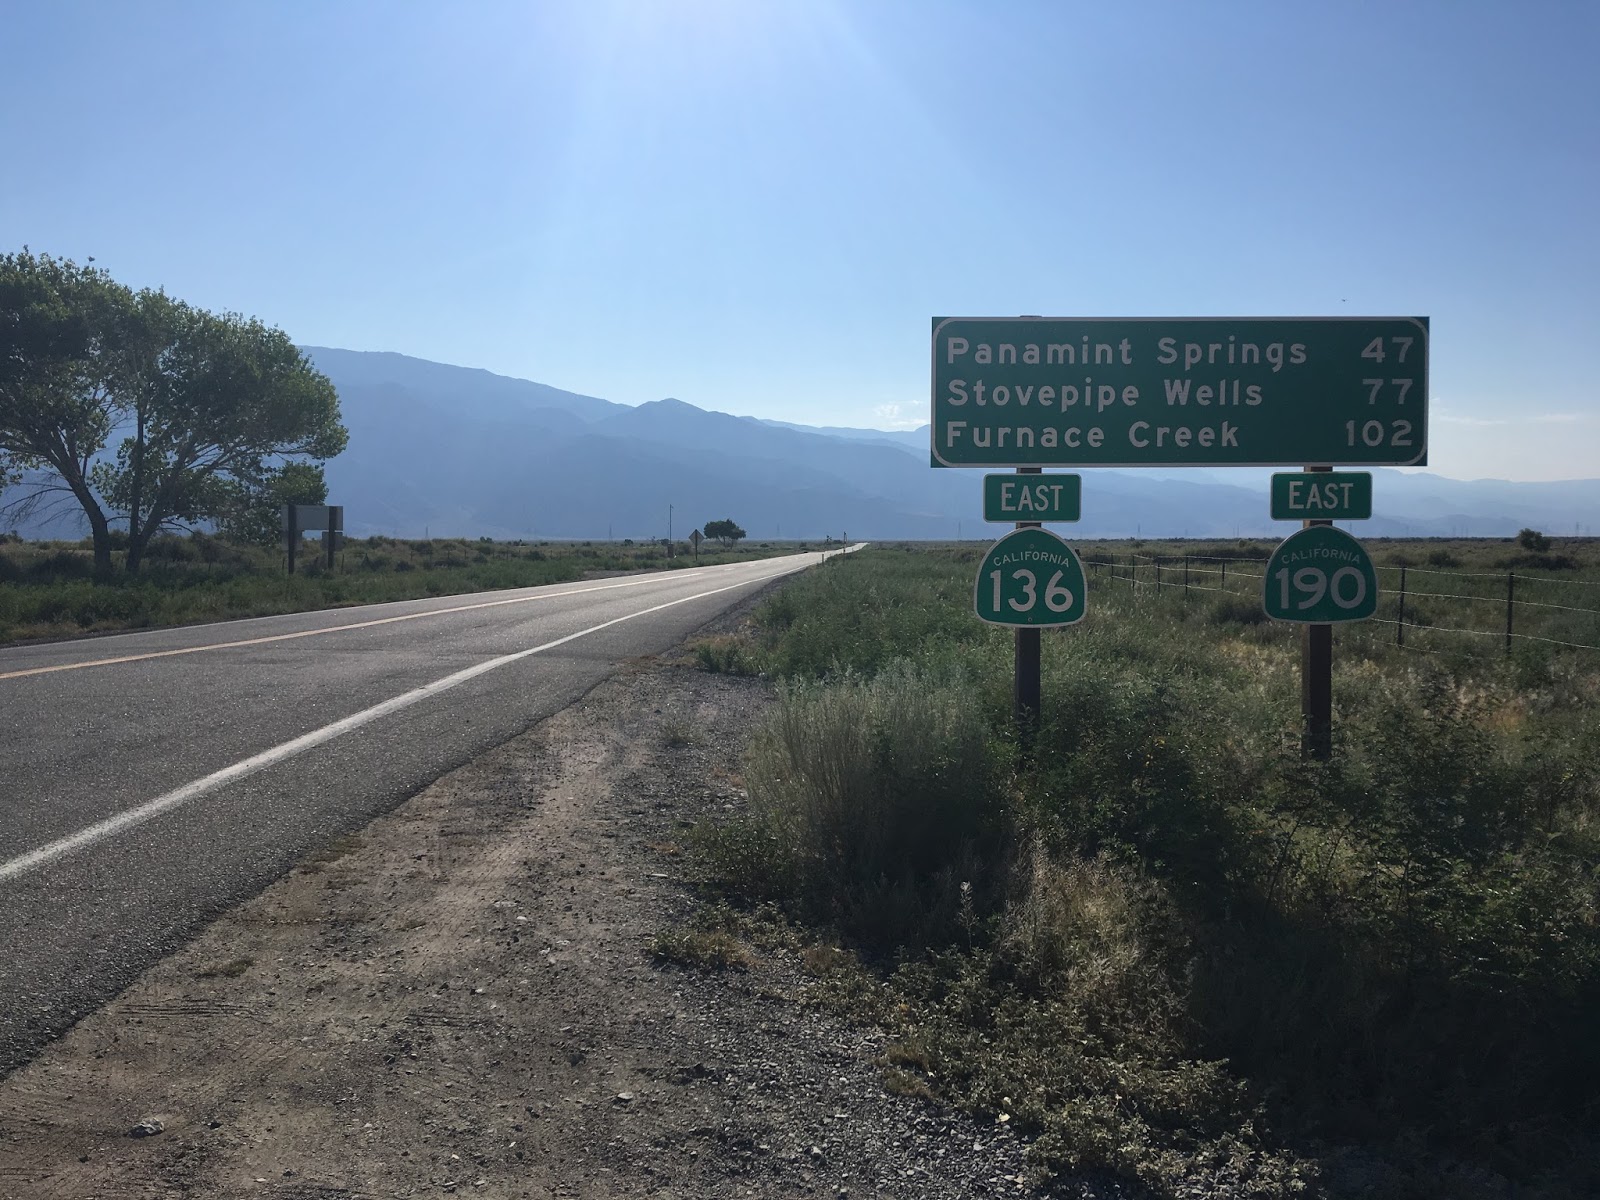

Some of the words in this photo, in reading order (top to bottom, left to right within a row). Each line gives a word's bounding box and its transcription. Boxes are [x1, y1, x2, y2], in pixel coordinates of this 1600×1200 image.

[946, 335, 1133, 365] Panamint
[1157, 335, 1307, 373] Springs
[1361, 336, 1414, 364] 47
[947, 377, 1140, 412] Stovepipe
[1163, 378, 1263, 406] Wells
[1362, 378, 1414, 405] 77
[946, 421, 1105, 448] Furnace
[1128, 420, 1239, 448] Creek
[1346, 419, 1413, 447] 102
[1000, 482, 1064, 511] EAST
[1288, 481, 1355, 509] EAST
[992, 550, 1071, 568] CALIFORNIA
[1280, 547, 1361, 565] CALIFORNIA
[989, 570, 1074, 612] 136
[1275, 566, 1366, 609] 190
